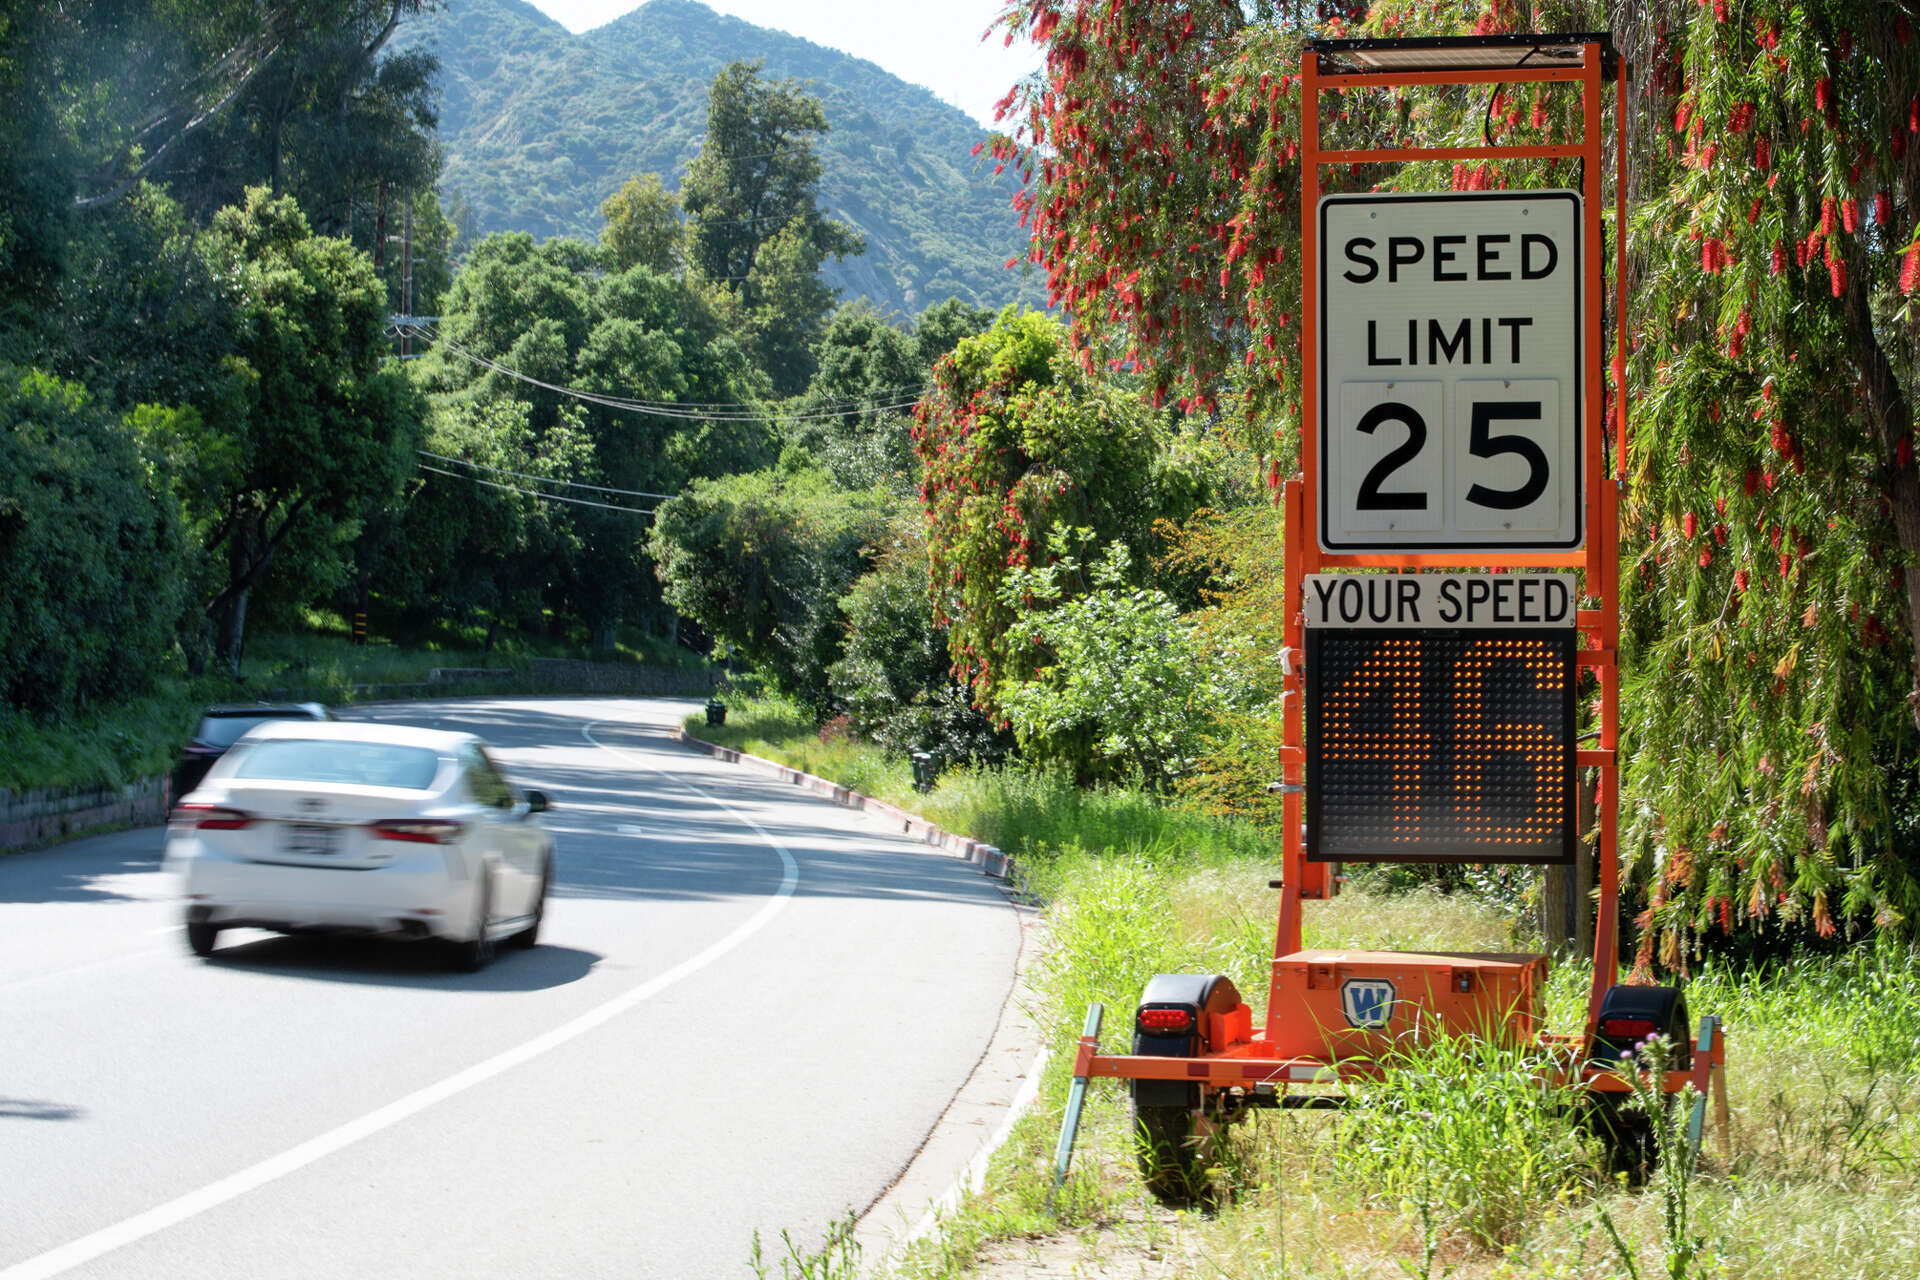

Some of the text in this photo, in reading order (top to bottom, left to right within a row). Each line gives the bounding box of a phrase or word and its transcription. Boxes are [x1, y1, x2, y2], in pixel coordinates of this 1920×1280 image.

[1343, 234, 1558, 284] SPEED
[1367, 317, 1533, 366] LIMIT
[1356, 401, 1550, 510] 25
[1313, 579, 1568, 623] YOUR SPEED
[1322, 640, 1563, 844] 46
[1350, 987, 1388, 1020] W
